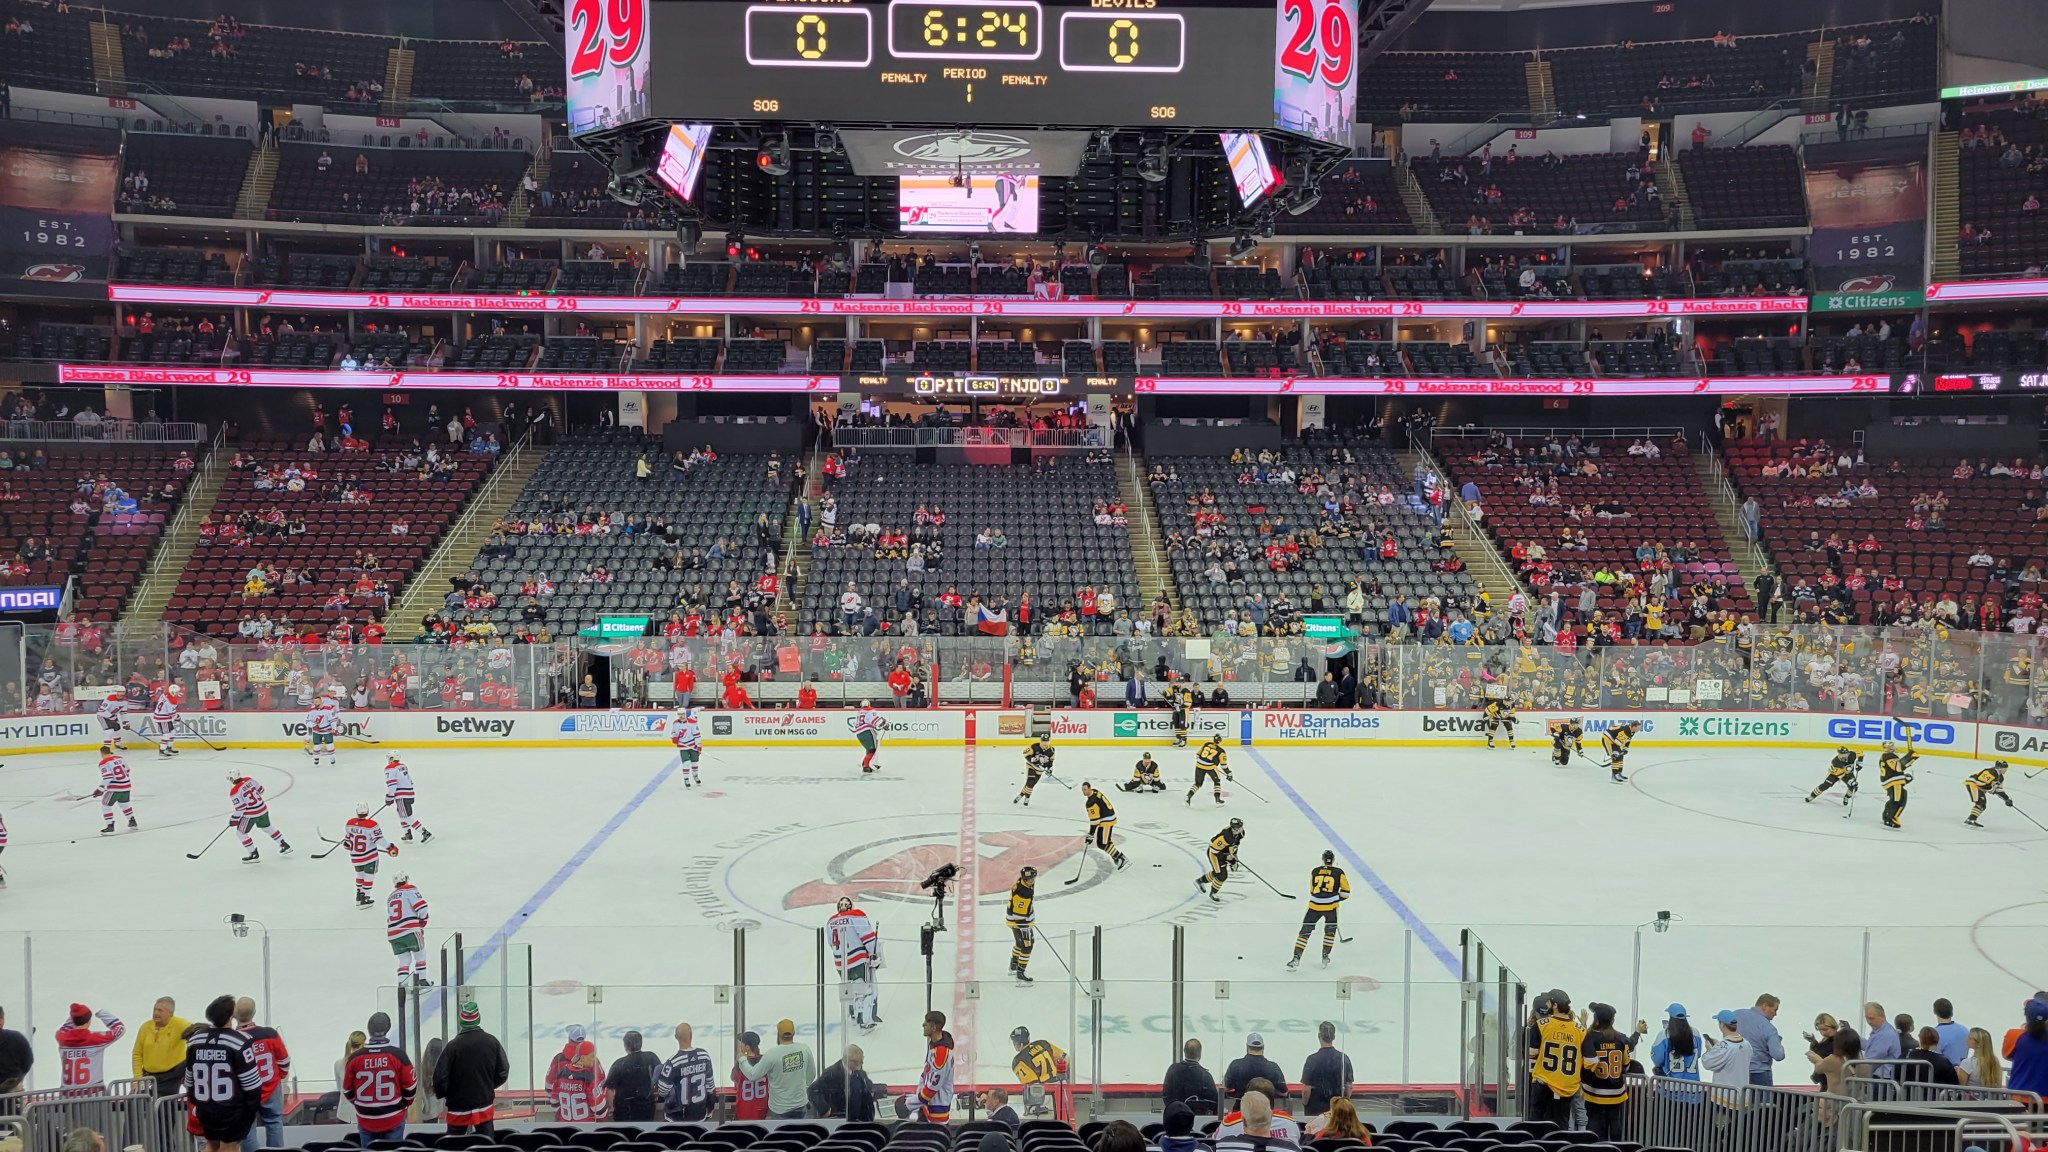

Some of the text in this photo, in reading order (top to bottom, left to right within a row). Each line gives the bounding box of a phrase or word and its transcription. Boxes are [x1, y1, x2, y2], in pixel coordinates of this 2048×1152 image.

[924, 10, 1027, 47] 6:24
[571, 0, 645, 77] 29
[796, 14, 827, 59] 0
[1108, 19, 1139, 63] 0
[1281, 0, 1353, 86] 29
[881, 73, 927, 84] PENALTY
[943, 68, 987, 79] PERIOD
[1002, 75, 1048, 86] PENALTY
[1959, 83, 2010, 97] Heineken
[115, 99, 130, 109] 115
[753, 99, 779, 112] SOG
[1150, 106, 1176, 118] SOG
[1810, 114, 1826, 123] 108
[381, 118, 395, 127] 114
[1519, 130, 1533, 138] 109
[883, 161, 1040, 170] Prudential
[39, 219, 78, 231] EST.
[24, 231, 85, 248] 1982
[1851, 233, 1888, 244] EST.
[1836, 246, 1895, 261] 1982
[368, 295, 577, 311] 29 Mackenzie Blackwood 29
[800, 300, 1003, 314] 29 Mackenzie Blackwood 29
[1222, 302, 1423, 315] 29 Mackenzie Blackwood 29
[1647, 301, 1669, 314] 29
[1681, 301, 1757, 313] Mackenzie
[1844, 295, 1905, 309] Citizens
[128, 371, 216, 383] Blackwood
[227, 372, 252, 385] 29
[497, 375, 713, 389] 29 Mackenzie Blackwood 29
[920, 380, 929, 390] 0
[972, 380, 995, 390] 6:24
[1087, 378, 1117, 386] PENALTY
[1851, 377, 1878, 391] 29
[2020, 374, 2039, 387] SAT
[935, 378, 964, 393] PIT
[1011, 378, 1040, 393] NJD
[1046, 381, 1054, 390] 0
[1135, 380, 1156, 393] 29
[1384, 380, 1594, 394] 29 Mackenzie Blackwood 29
[390, 394, 402, 404] 10
[1553, 400, 1559, 408] 6
[611, 623, 645, 632] Citizens
[1305, 622, 1338, 632] Citizens
[140, 715, 227, 735] Aantic
[437, 716, 515, 737] betway
[577, 714, 649, 732] HALMAR
[744, 716, 826, 724] STREAM GAMES
[1120, 718, 1227, 733] enterrise
[1423, 716, 1488, 733] betwa
[1703, 716, 1790, 736] Citizens
[282, 719, 362, 737] veon
[1279, 728, 1327, 738] HEALTH
[1828, 718, 1955, 745] GEICO
[714, 822, 807, 850] Center
[1313, 875, 1335, 894] 73
[1141, 1014, 1381, 1035] Citizens
[1553, 1031, 1574, 1043] LETANG
[196, 1050, 227, 1061] HUGHES
[1542, 1041, 1578, 1076] 58
[1669, 1048, 1699, 1074] 87
[364, 1057, 388, 1069] ELIAS
[1032, 1050, 1057, 1082] 71
[1596, 1050, 1623, 1079] 58
[63, 1058, 91, 1085] 96
[192, 1062, 235, 1101] 86
[355, 1070, 396, 1102] 26
[680, 1073, 706, 1104] 13
[741, 1079, 767, 1101] 86
[558, 1092, 588, 1121] 86
